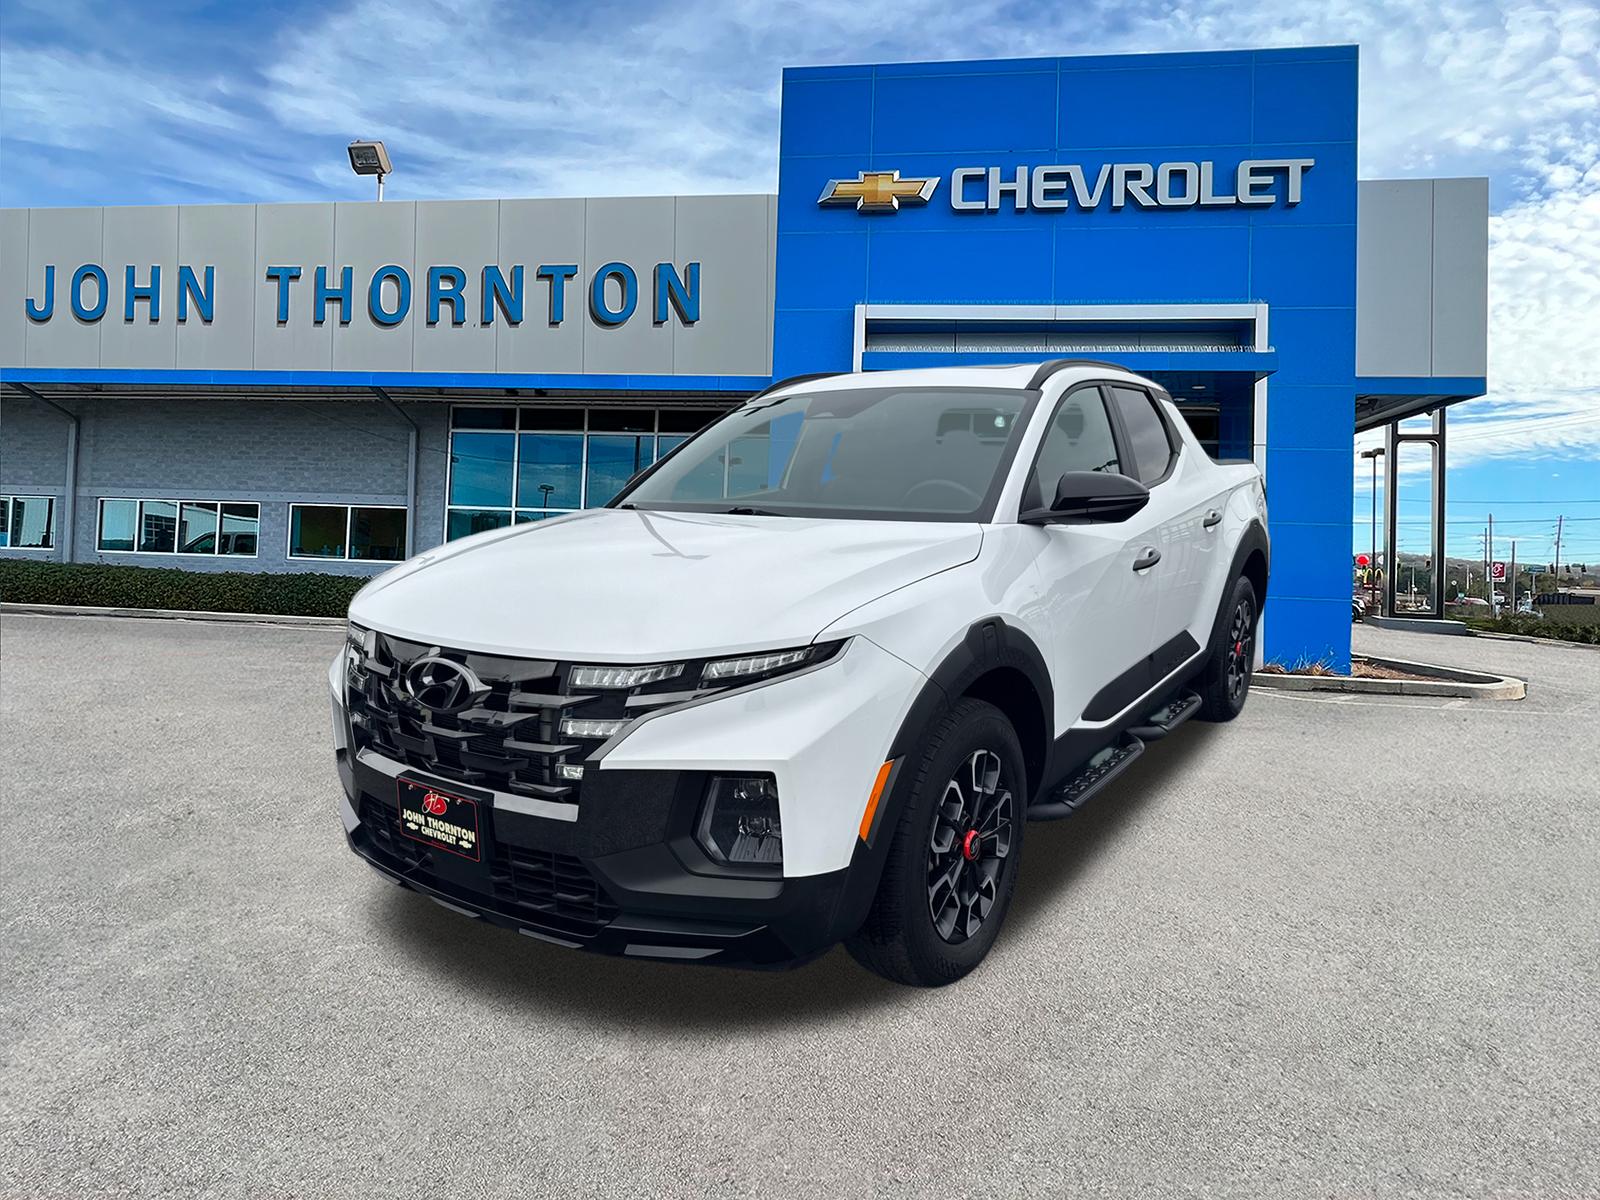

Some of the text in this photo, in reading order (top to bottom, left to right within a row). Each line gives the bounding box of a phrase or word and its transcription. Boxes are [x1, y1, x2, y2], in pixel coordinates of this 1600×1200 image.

[951, 159, 1315, 212] CHEVROLET
[26, 261, 702, 327] JOHN THORNTON
[403, 808, 476, 842] JOHN THORNTON
[421, 825, 456, 845] CHEVROLET
